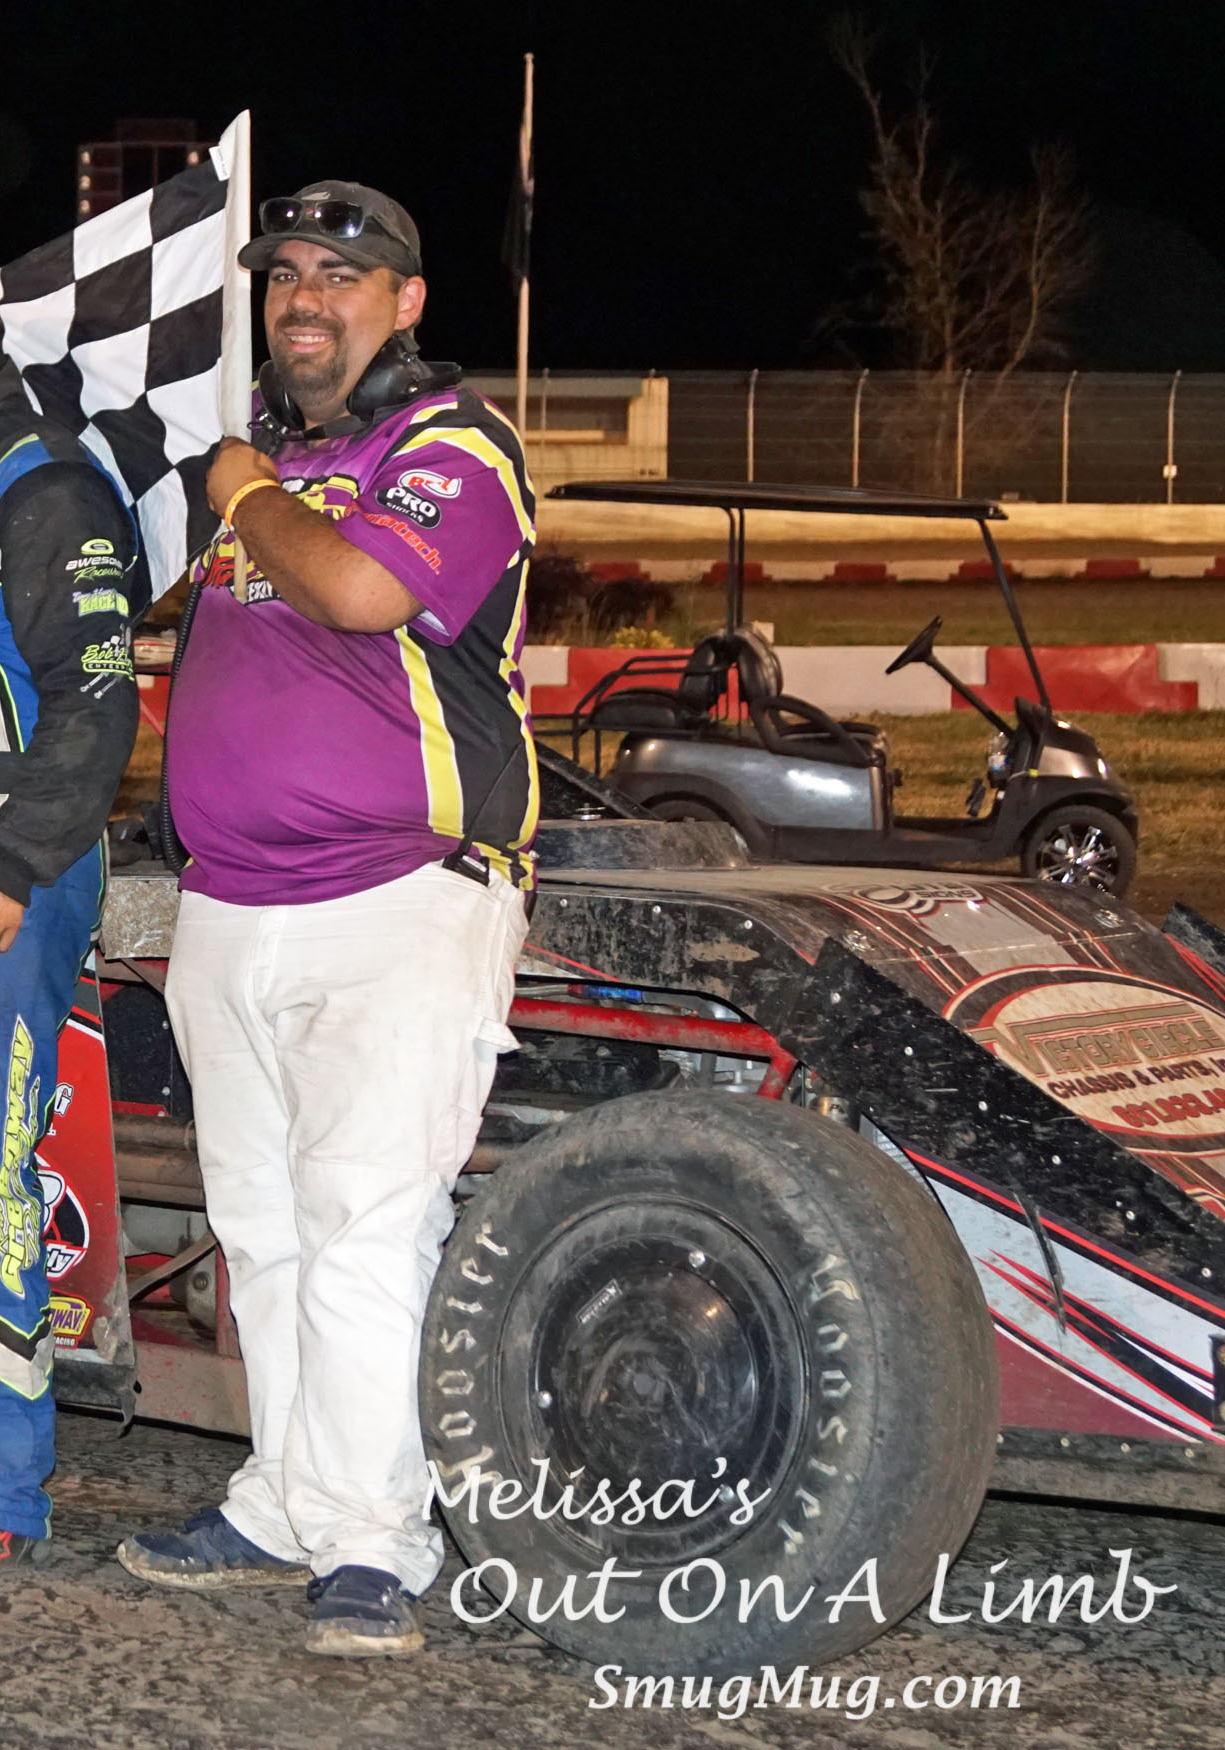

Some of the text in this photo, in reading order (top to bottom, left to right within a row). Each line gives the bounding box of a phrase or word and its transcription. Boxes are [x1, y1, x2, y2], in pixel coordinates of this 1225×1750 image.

[386, 487, 436, 517] PRO
[916, 889, 977, 899] SIGNS
[1047, 1071, 1137, 1099] CHASSIS
[1132, 1069, 1155, 1086] &
[1147, 1059, 1220, 1085] PARTS,
